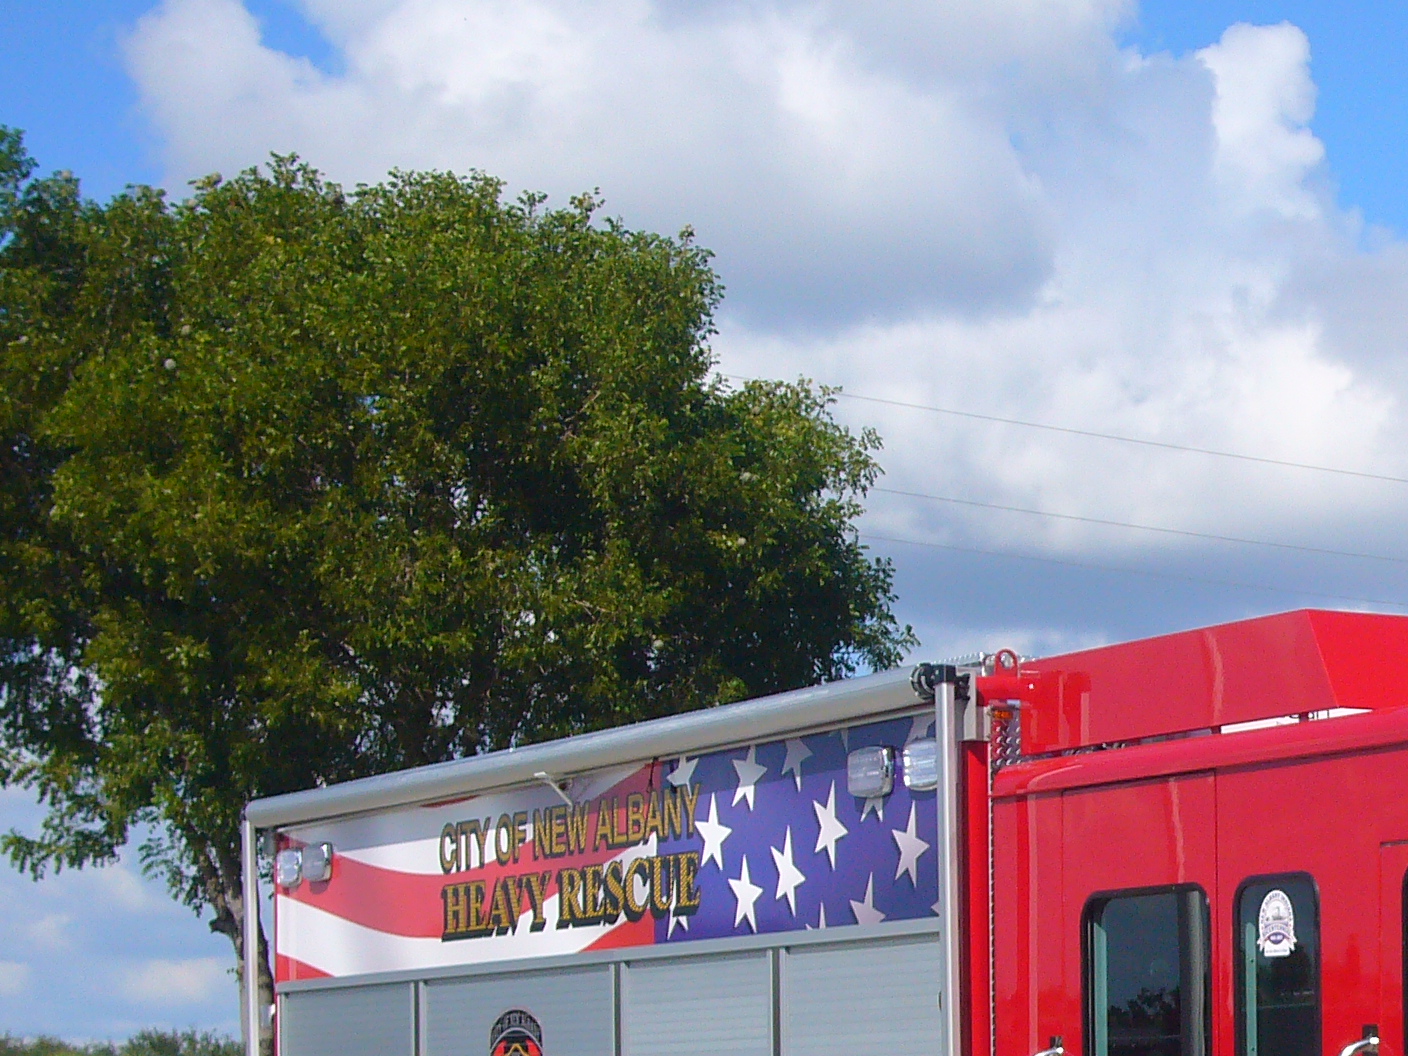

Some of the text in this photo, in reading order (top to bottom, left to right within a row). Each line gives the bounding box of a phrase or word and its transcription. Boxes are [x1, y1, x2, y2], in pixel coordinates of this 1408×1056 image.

[440, 783, 700, 875] CITY OF NEW ALBANY
[441, 851, 700, 942] HEAVY RESCUE
